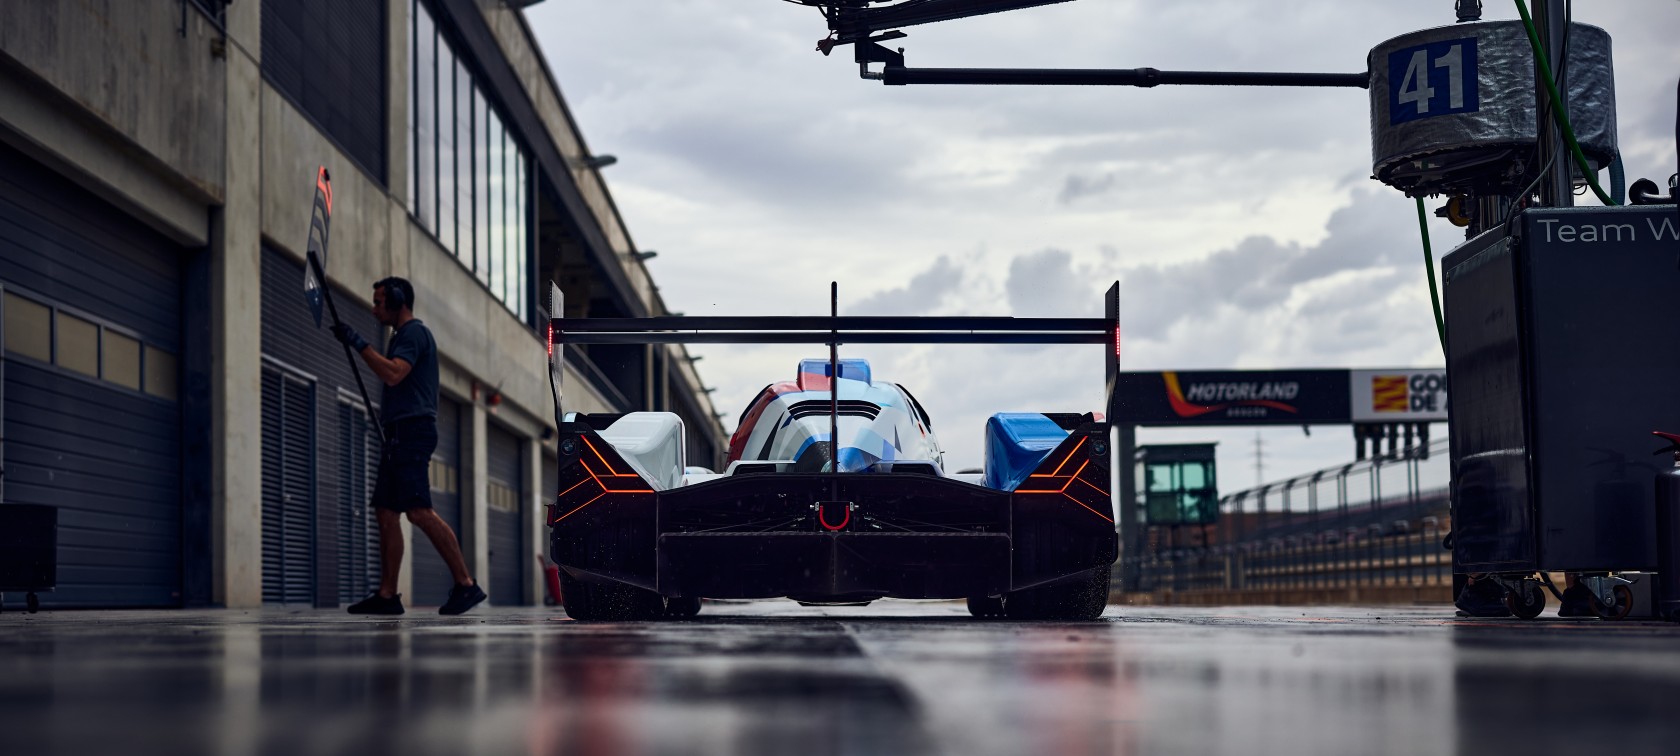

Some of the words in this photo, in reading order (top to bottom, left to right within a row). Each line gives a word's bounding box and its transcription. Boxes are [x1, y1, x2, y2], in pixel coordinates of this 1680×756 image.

[1398, 44, 1464, 114] 41
[1537, 218, 1635, 243] Team
[1187, 382, 1299, 400] MOTORLAND
[1410, 394, 1437, 412] DE
